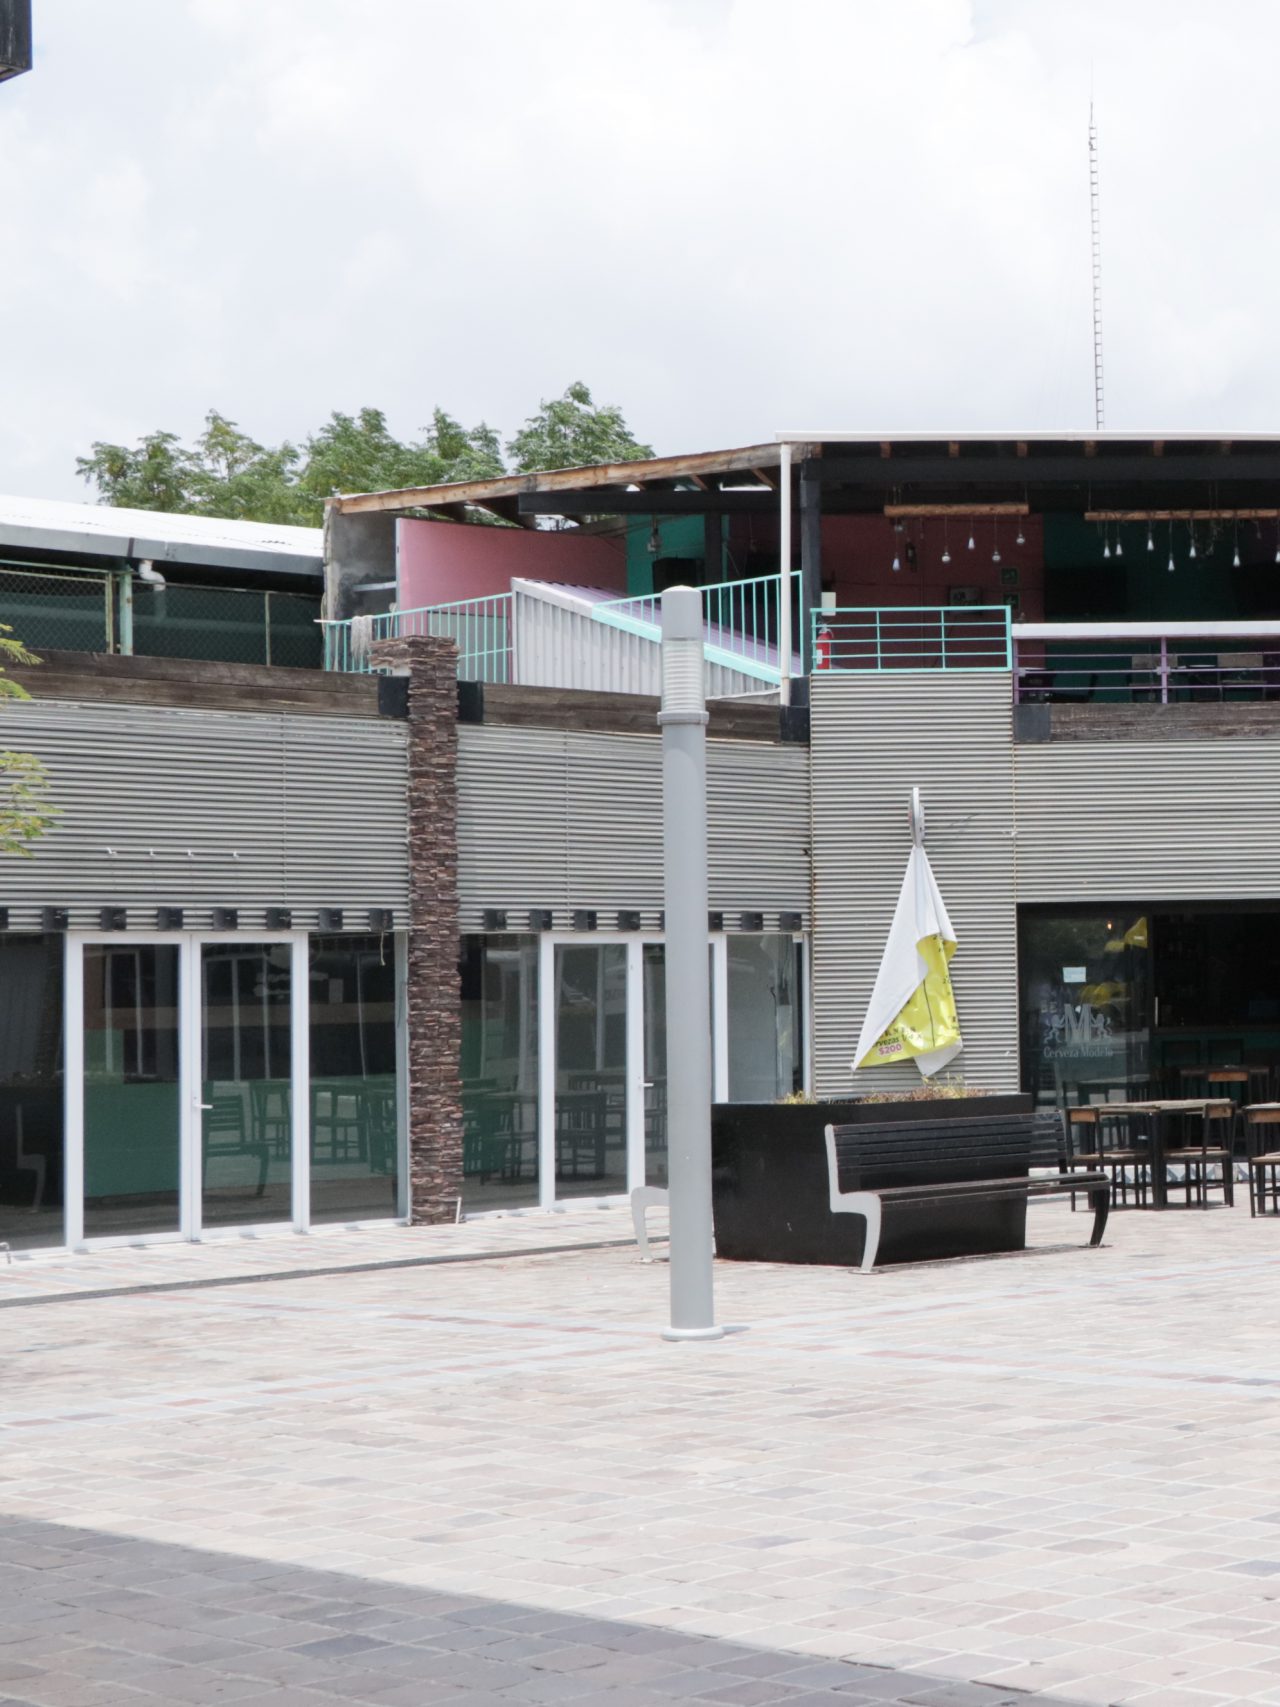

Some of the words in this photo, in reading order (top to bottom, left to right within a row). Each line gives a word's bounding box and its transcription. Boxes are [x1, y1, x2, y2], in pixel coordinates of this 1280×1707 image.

[879, 1043, 902, 1056] $200
[1043, 1046, 1079, 1058] Cerveza
[1080, 1043, 1113, 1058] Modelo
